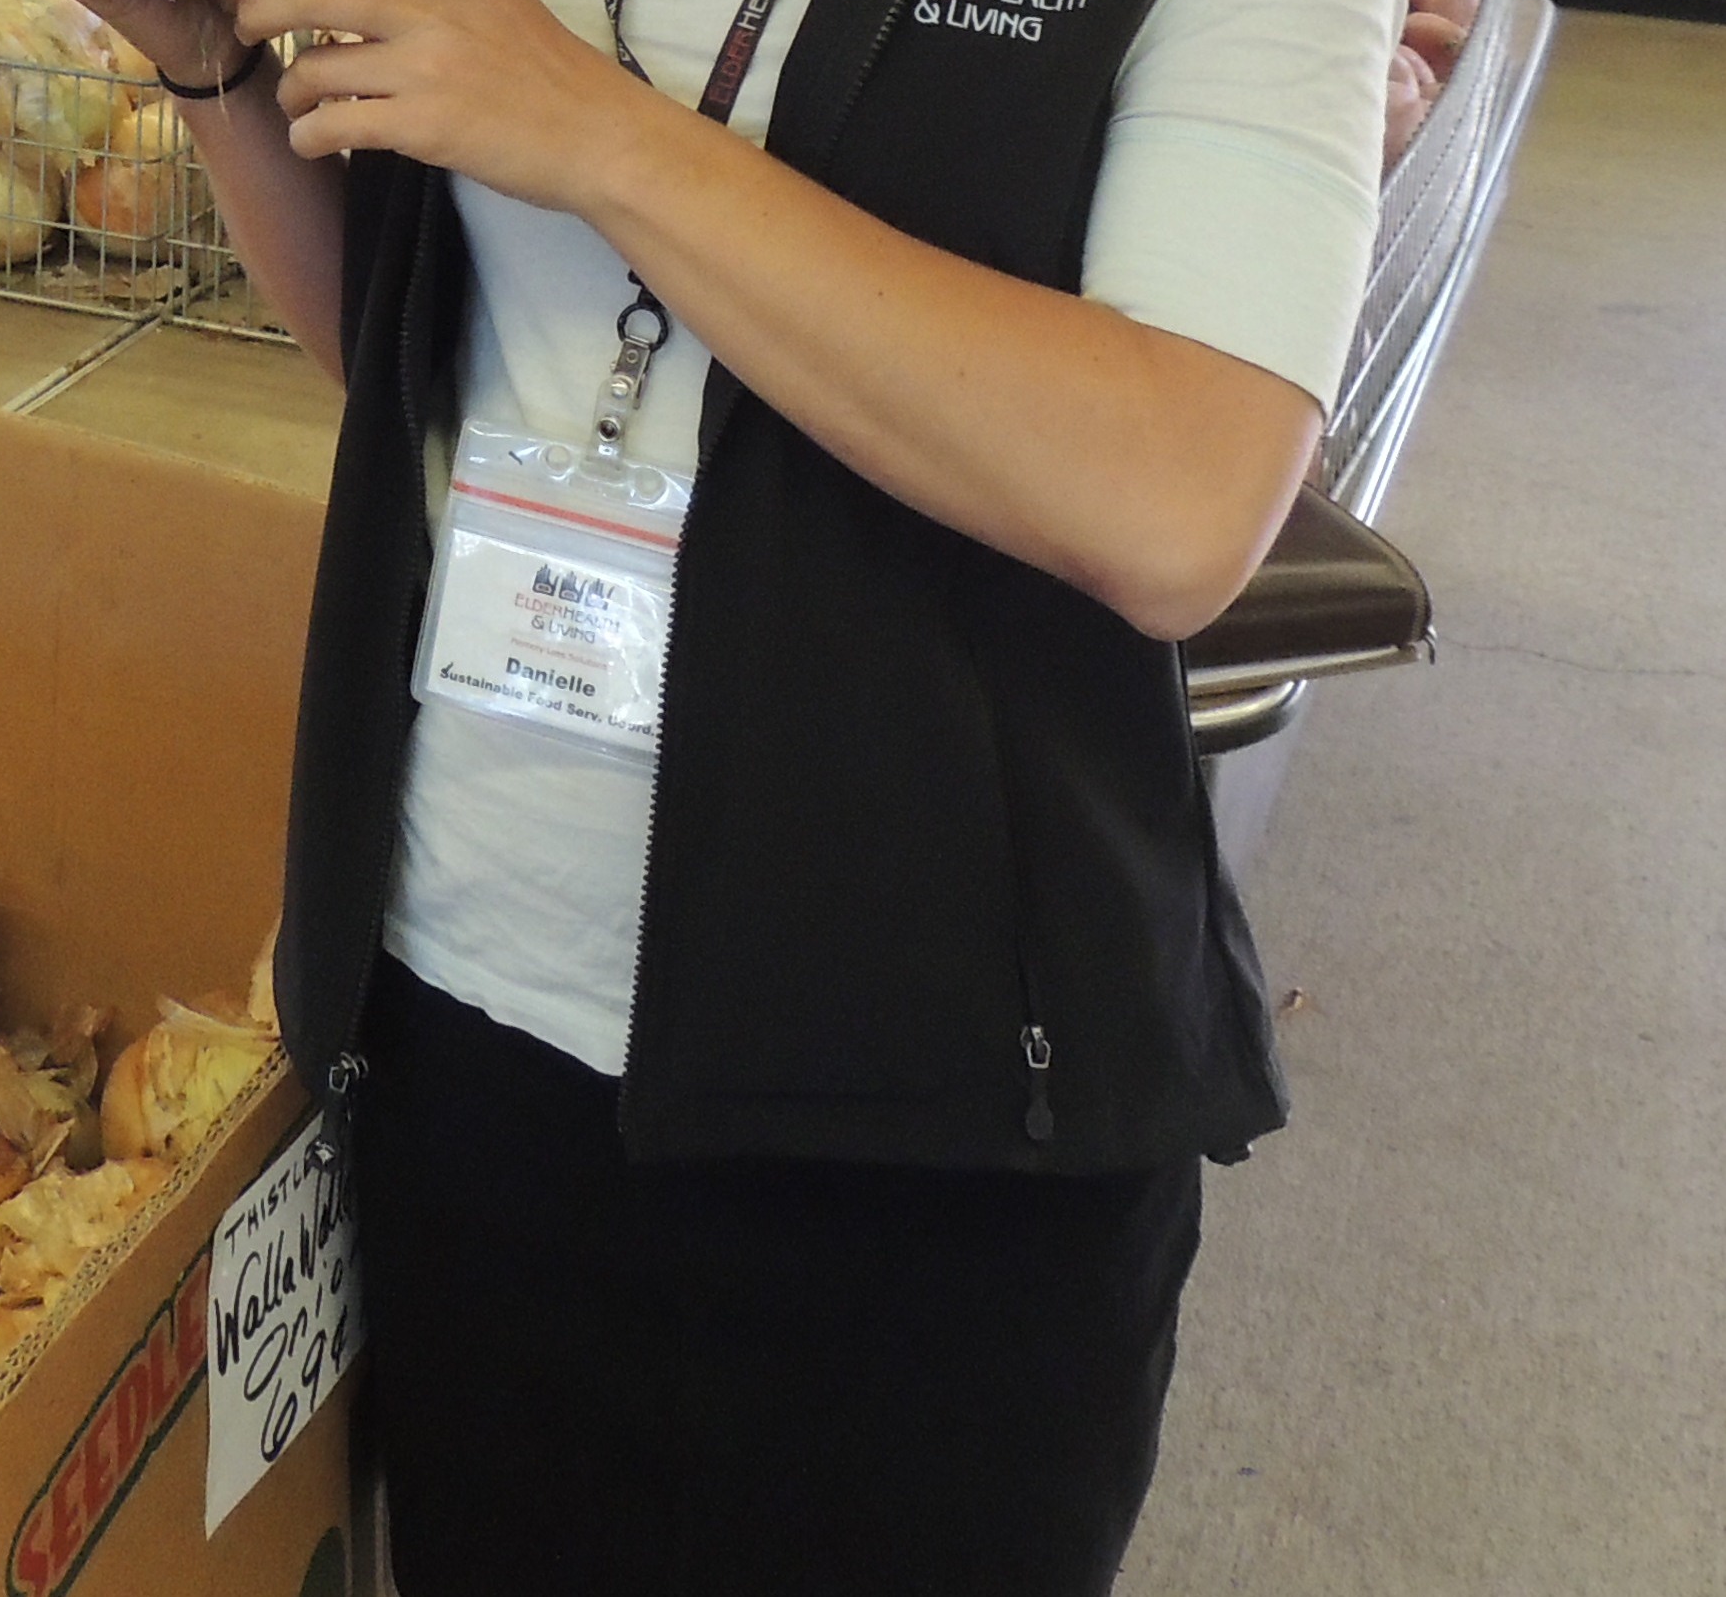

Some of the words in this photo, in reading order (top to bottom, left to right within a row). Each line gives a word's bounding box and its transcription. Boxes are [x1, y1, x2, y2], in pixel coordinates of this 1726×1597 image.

[530, 614, 545, 631] &
[547, 619, 596, 644] LIVING
[439, 668, 523, 701] Sustainable
[526, 690, 562, 712] Food
[566, 703, 602, 723] Serv.
[505, 656, 596, 697] Danielle
[215, 1231, 297, 1377] Walla
[300, 1169, 353, 1281] Wall
[244, 1245, 356, 1402] Onio
